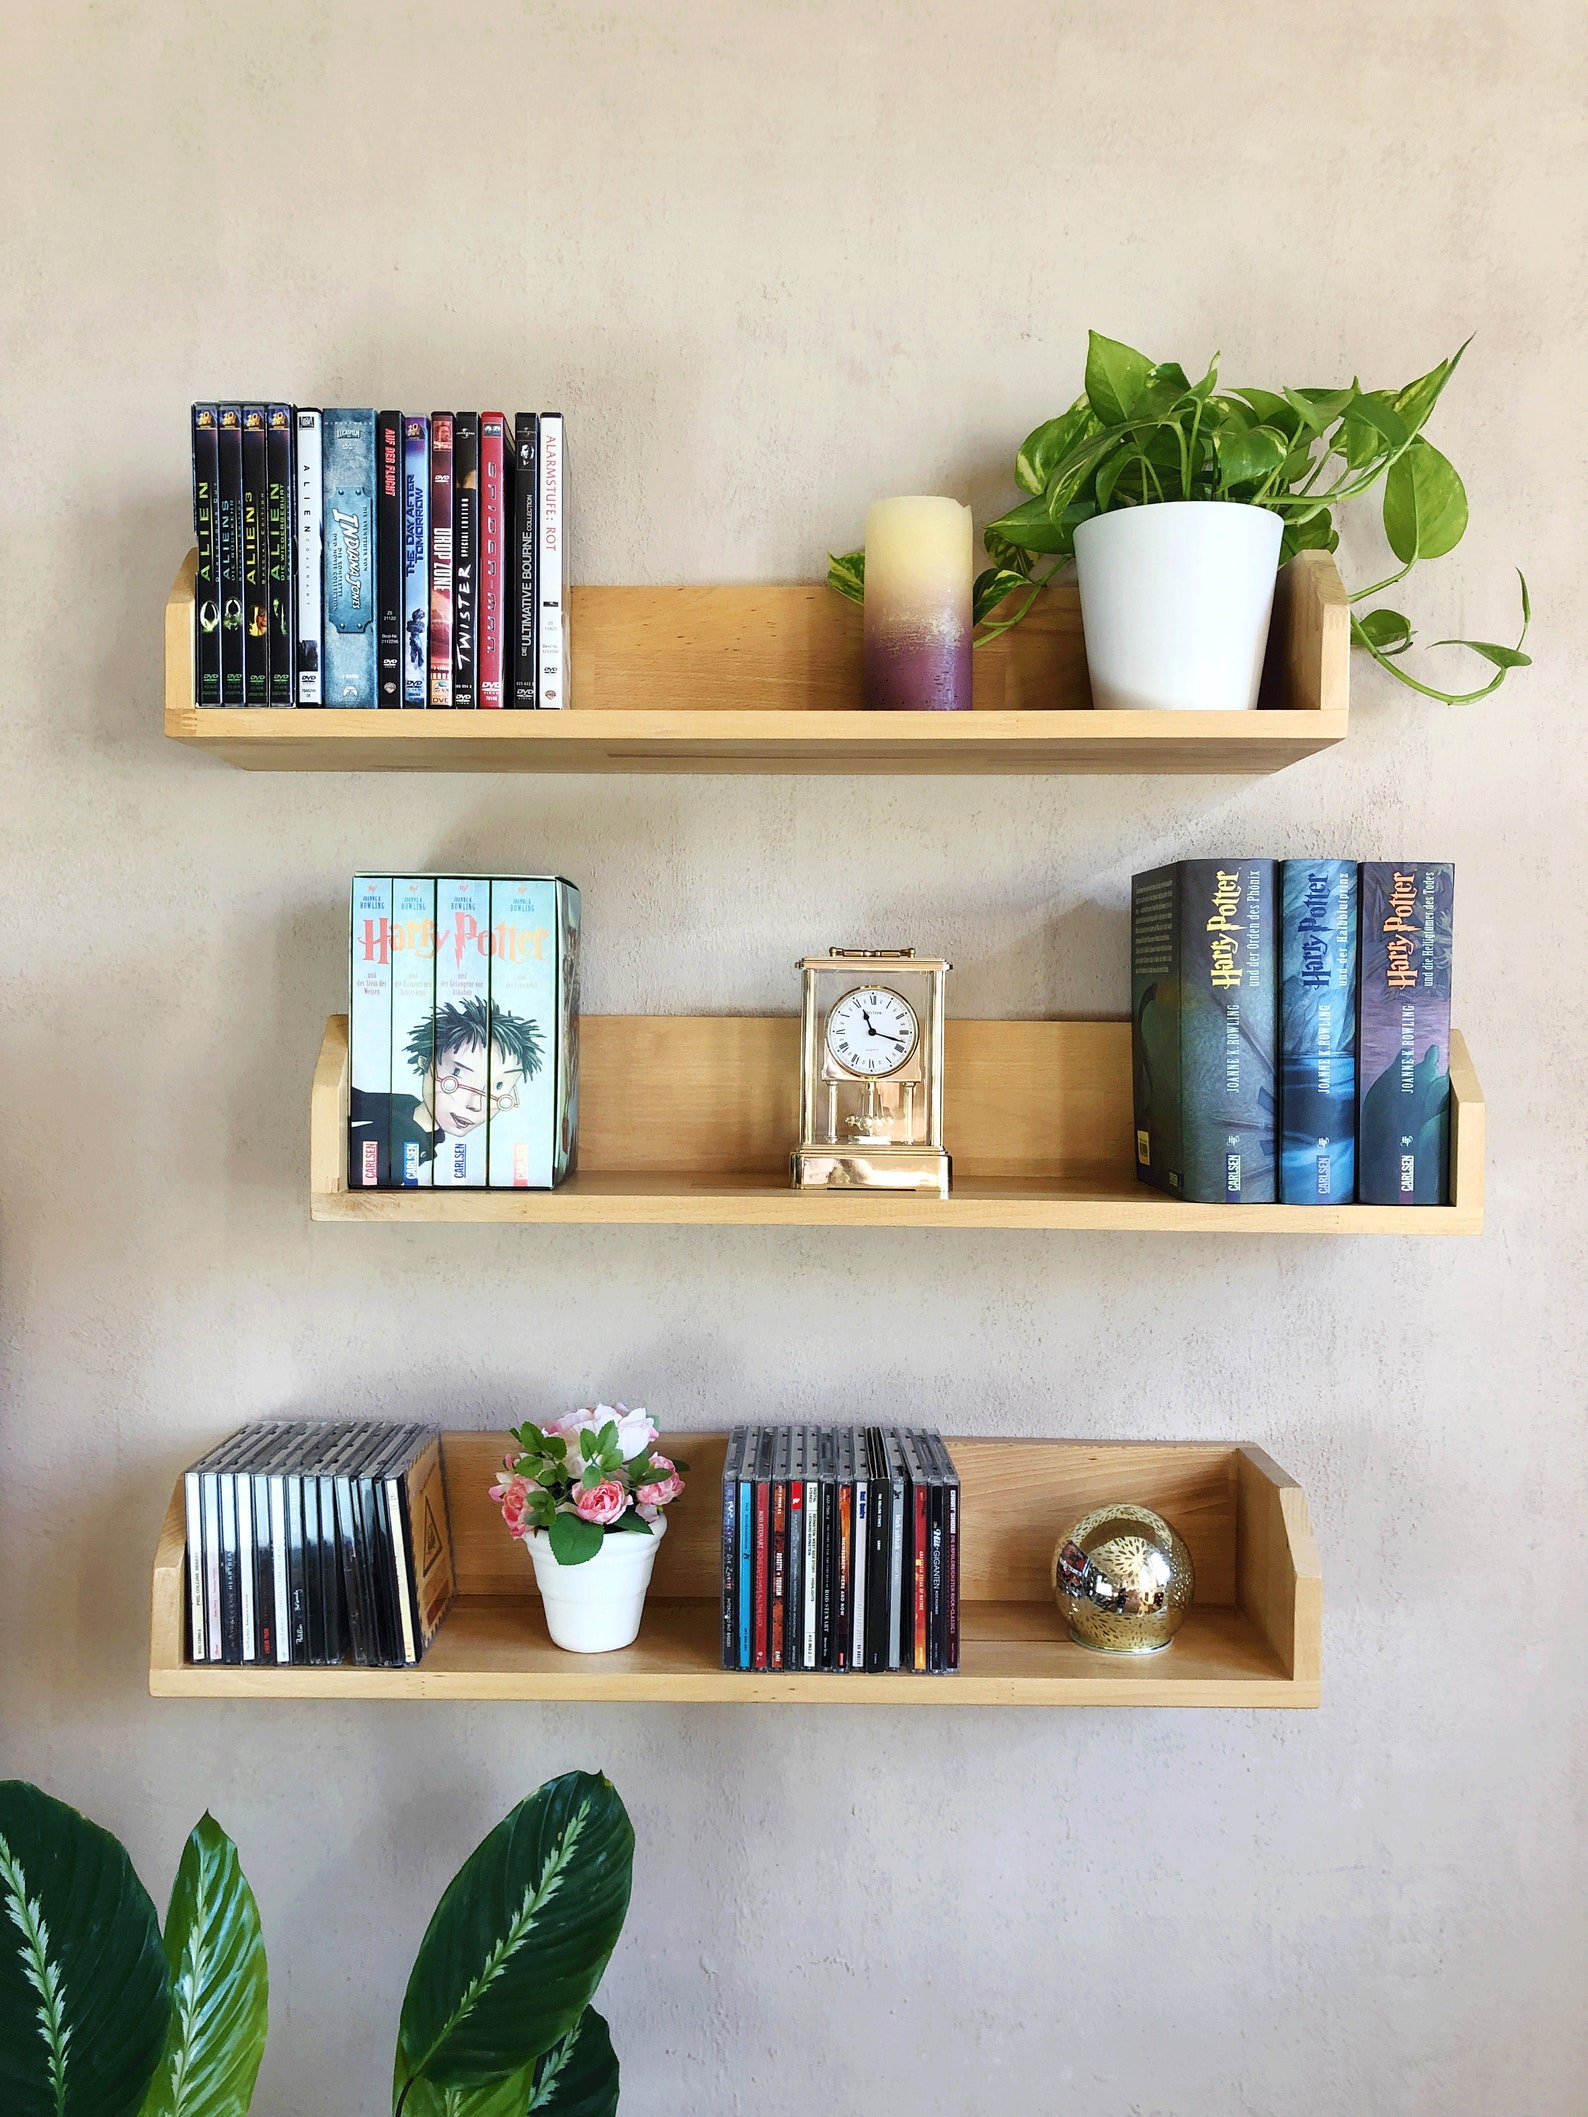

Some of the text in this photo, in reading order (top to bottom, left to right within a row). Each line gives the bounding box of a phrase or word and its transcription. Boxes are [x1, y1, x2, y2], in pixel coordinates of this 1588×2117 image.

[385, 428, 396, 497] AUF DER FLUCHT
[546, 435, 557, 552] ALARMSTUFE: ROT
[199, 482, 210, 582] ALIEN
[221, 500, 231, 580] ALIENS
[270, 483, 280, 581] ALIEN
[332, 508, 362, 609] INDIANA JONES
[406, 474, 415, 577] THE DAY AFTER
[415, 487, 424, 564] TOMORROW
[433, 528, 451, 591] DROP ZONE
[521, 532, 532, 580] BOURNE
[456, 498, 472, 670] TWISTER SPECIAL EDITION
[521, 582, 532, 647] ULTIMATIVE
[357, 912, 549, 970] Harry Potter
[360, 902, 385, 910] ROWLING
[450, 902, 476, 910] ROWLING
[1206, 870, 1248, 990] Harry Potter
[1247, 870, 1260, 987] und der Orden des Phönix
[1297, 872, 1334, 991] Harry Potter
[1337, 873, 1349, 987] und der Halbblutprinz
[1383, 871, 1422, 990] Harry Potter
[1422, 872, 1435, 987] und die Heiligtümer des Todes
[1226, 1004, 1240, 1094] JOANNE K. ROWLING
[1317, 1005, 1331, 1094] JOANNE K. ROWLING
[1400, 1005, 1414, 1094] JOANNE K. ROWLING
[365, 1143, 376, 1179] CARLSEN
[405, 1144, 417, 1180] CARLSEN
[454, 1143, 465, 1179] CARLSEN
[1228, 1154, 1241, 1192] CARLSEN
[1318, 1157, 1330, 1194] CARLSEN
[1400, 1155, 1414, 1192] CARLSEN
